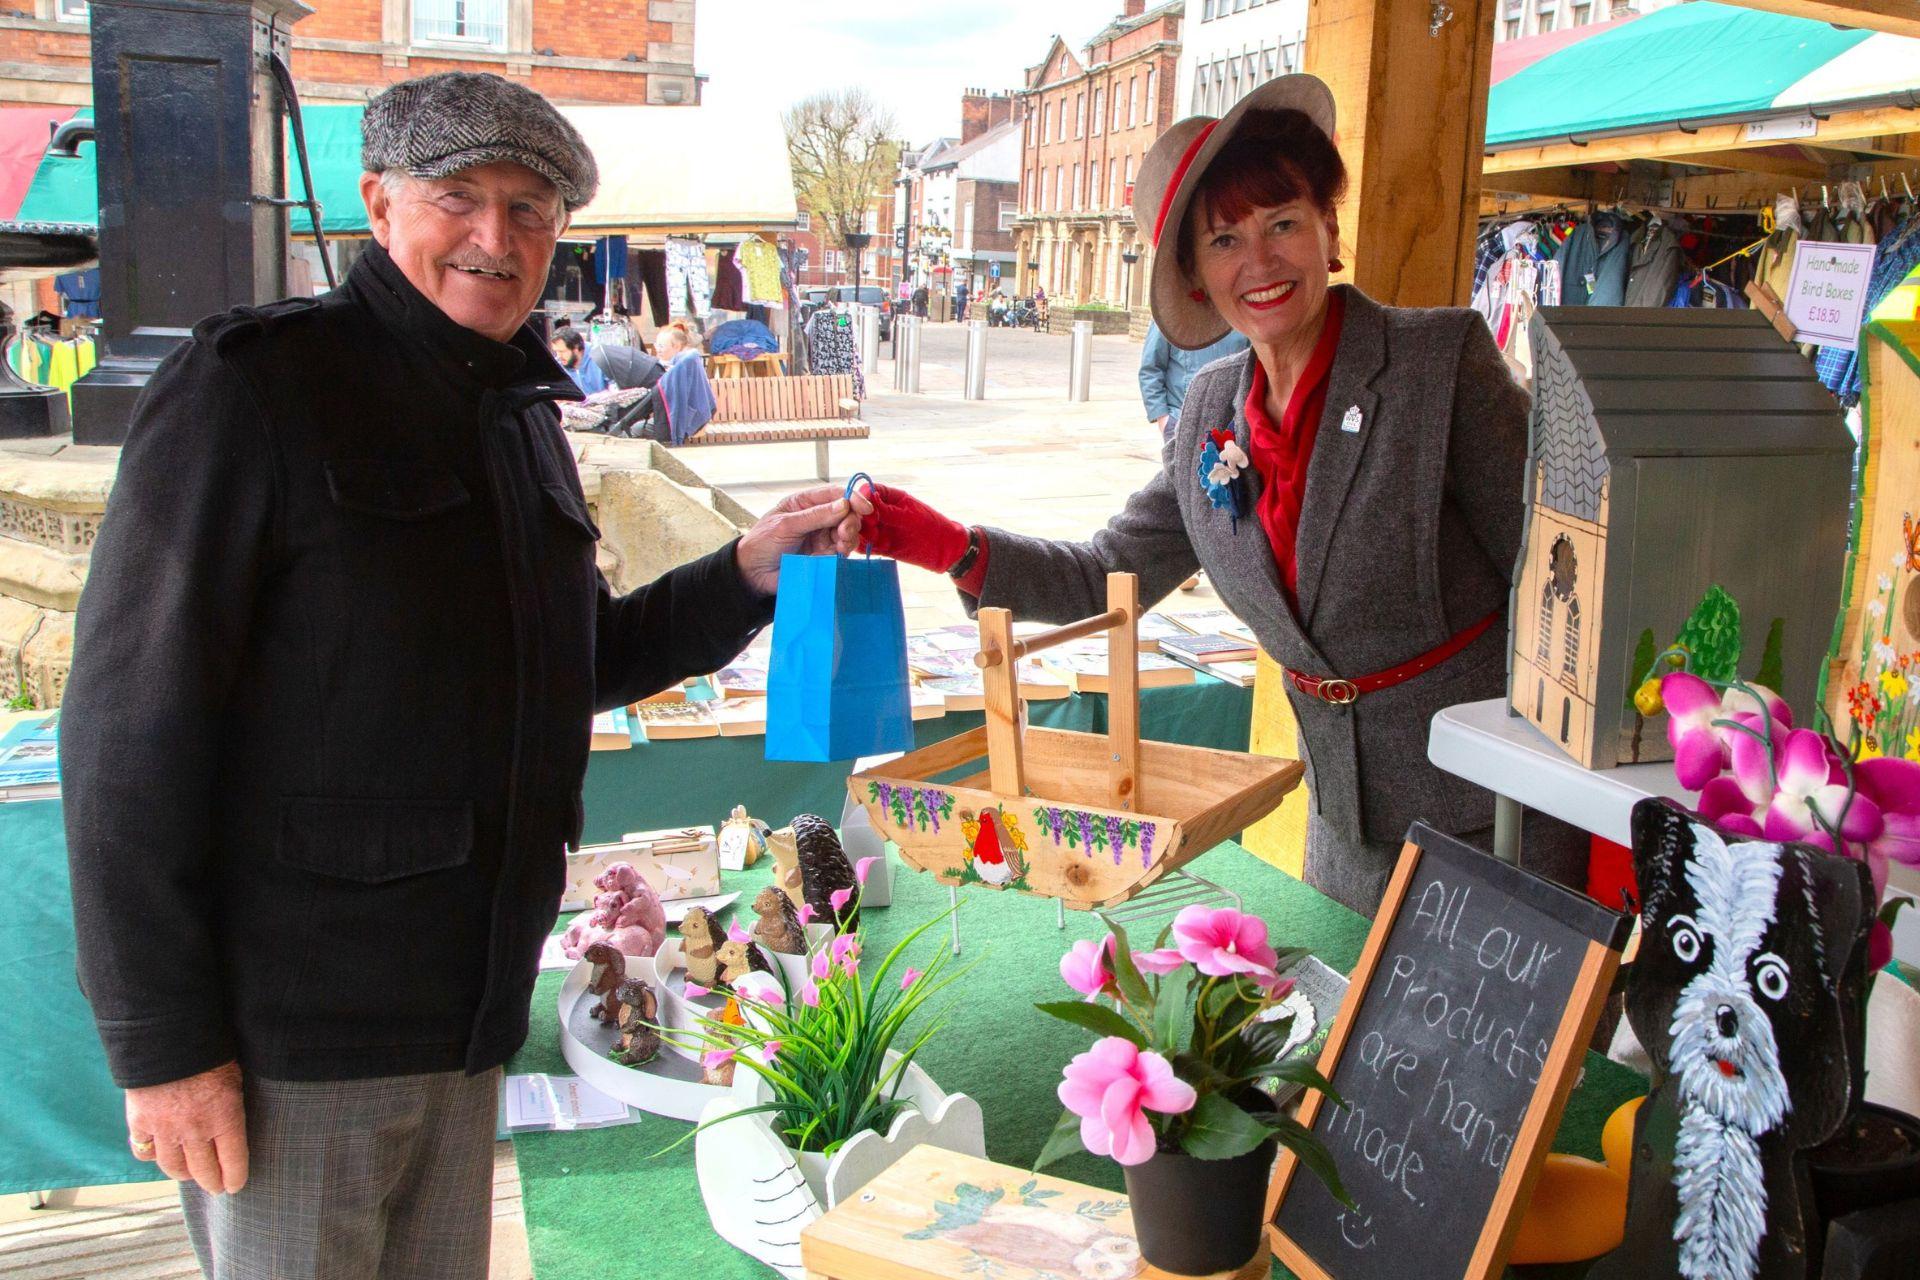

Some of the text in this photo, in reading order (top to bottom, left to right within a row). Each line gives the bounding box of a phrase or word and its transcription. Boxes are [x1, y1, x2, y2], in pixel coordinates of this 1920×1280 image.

[1802, 281, 1854, 300] Bird Boxes
[1809, 306, 1839, 322] £18.50
[1411, 880, 1471, 950] All
[1384, 953, 1548, 1084] Products
[1359, 1030, 1527, 1178] are hand
